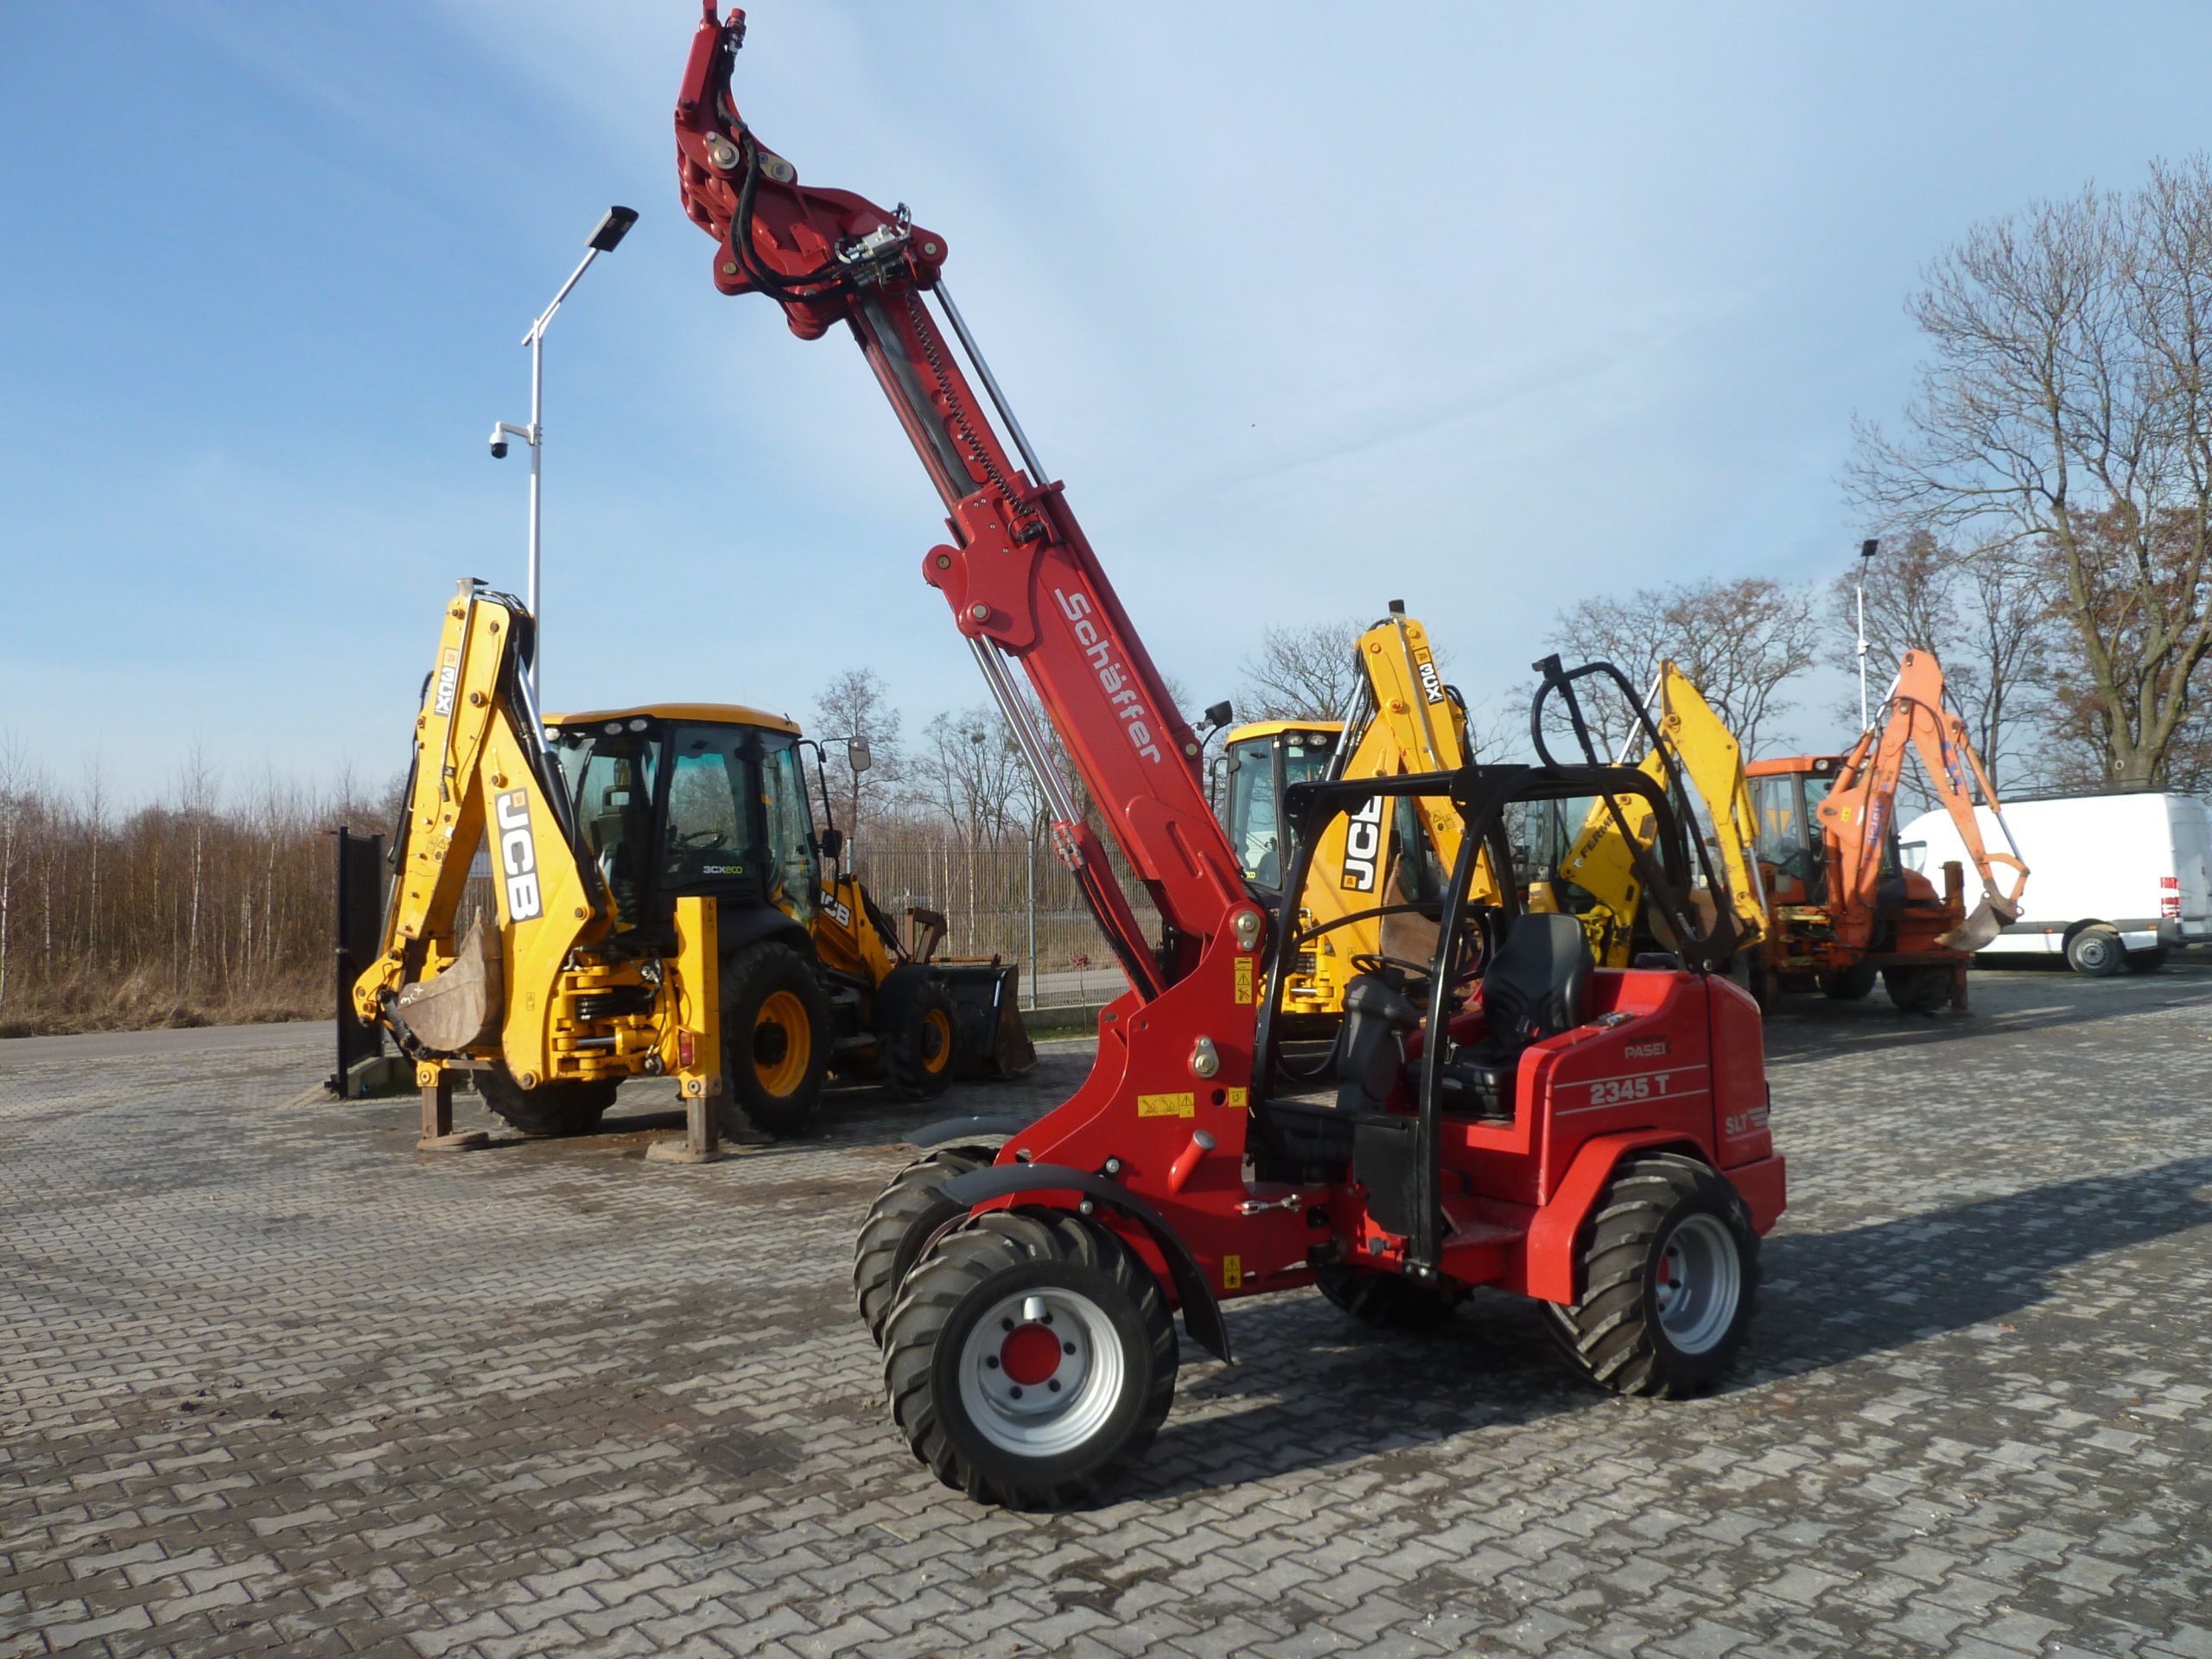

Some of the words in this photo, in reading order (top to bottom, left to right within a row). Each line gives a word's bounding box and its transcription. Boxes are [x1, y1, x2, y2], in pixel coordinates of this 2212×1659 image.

[1054, 588, 1160, 764] Schäffer
[1420, 663, 1443, 702] 3CX
[1580, 804, 1622, 858] FERME
[497, 794, 540, 920] JCB
[1590, 1077, 1649, 1105] 2345
[1655, 1074, 1669, 1095] T
[1726, 1114, 1747, 1135] SLT
